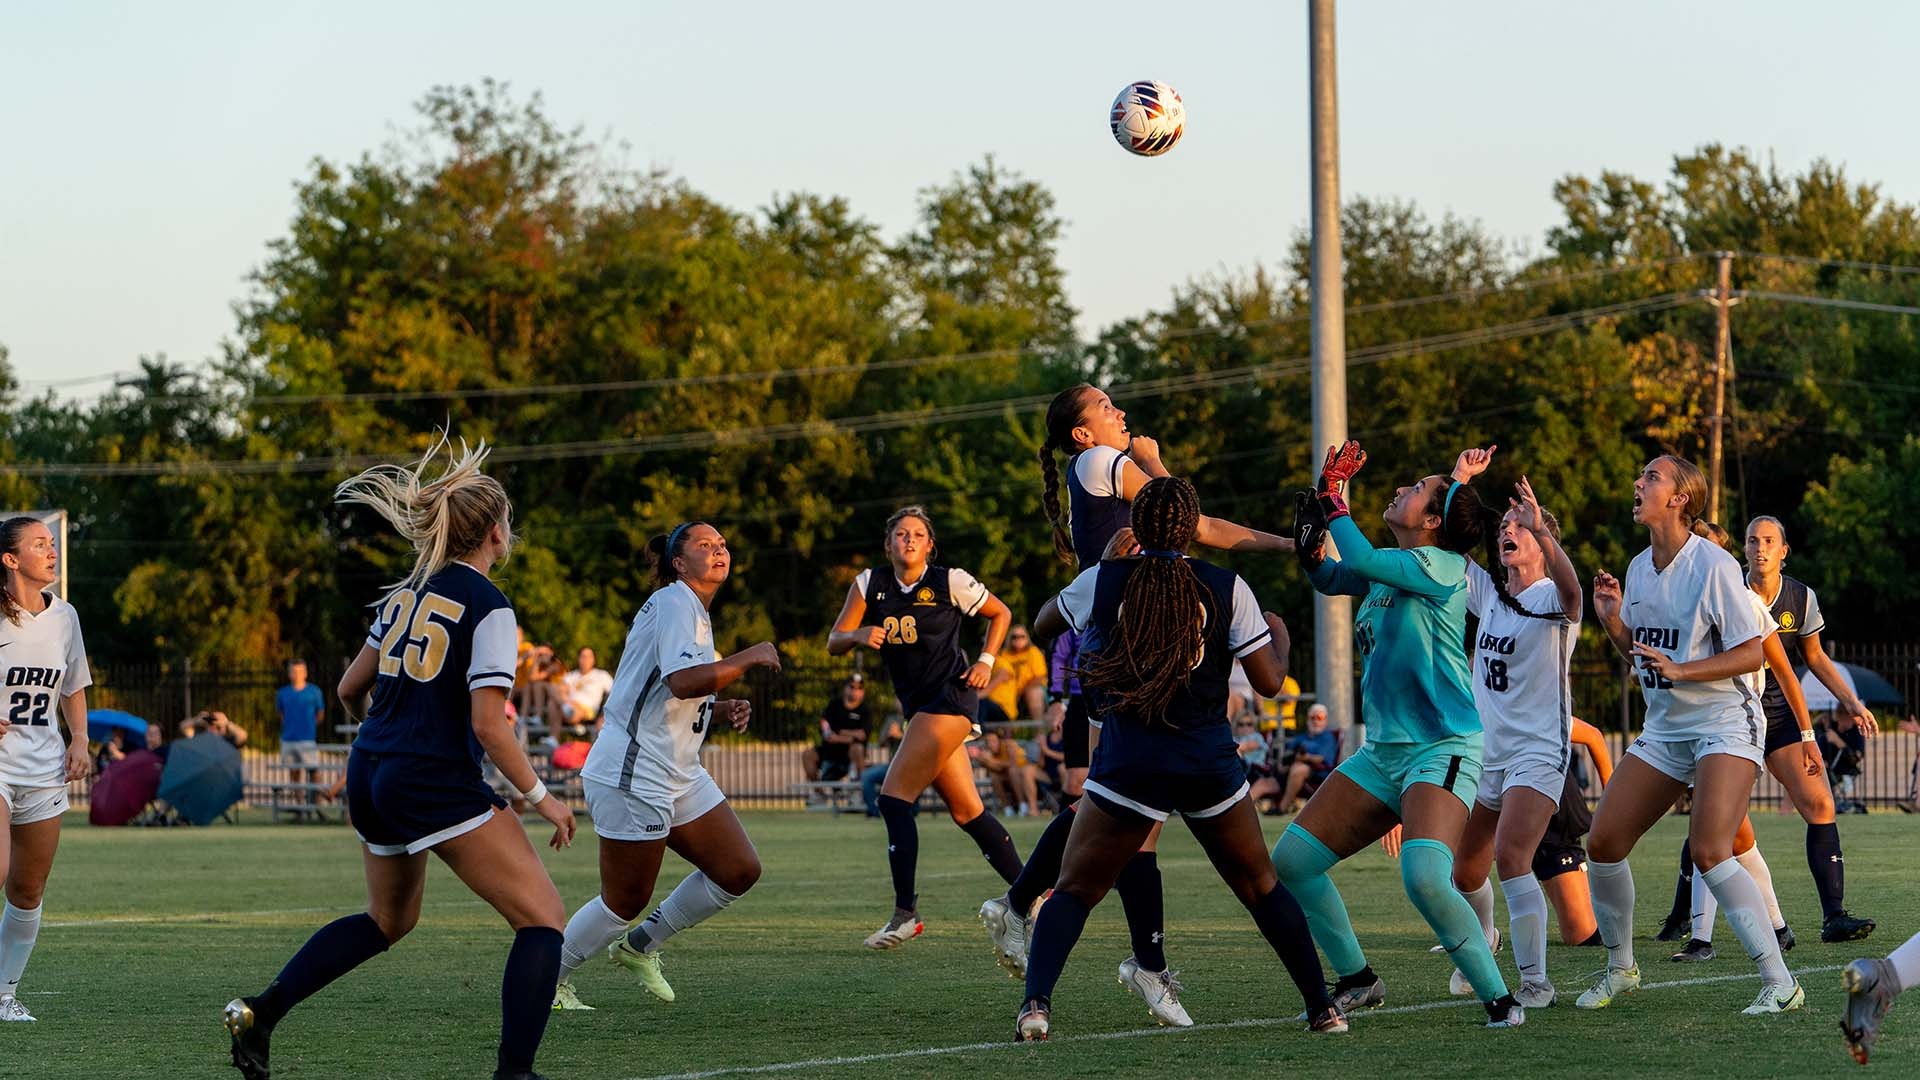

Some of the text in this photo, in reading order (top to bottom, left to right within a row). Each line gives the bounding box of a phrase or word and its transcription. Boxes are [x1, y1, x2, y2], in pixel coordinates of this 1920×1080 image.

[379, 588, 466, 683] 25
[883, 615, 919, 645] 26
[1479, 632, 1516, 655] ORU
[1635, 627, 1680, 651] ORU
[5, 666, 62, 689] ORU
[1483, 656, 1509, 692] 18
[9, 691, 50, 726] 22
[646, 824, 665, 833] ORU
